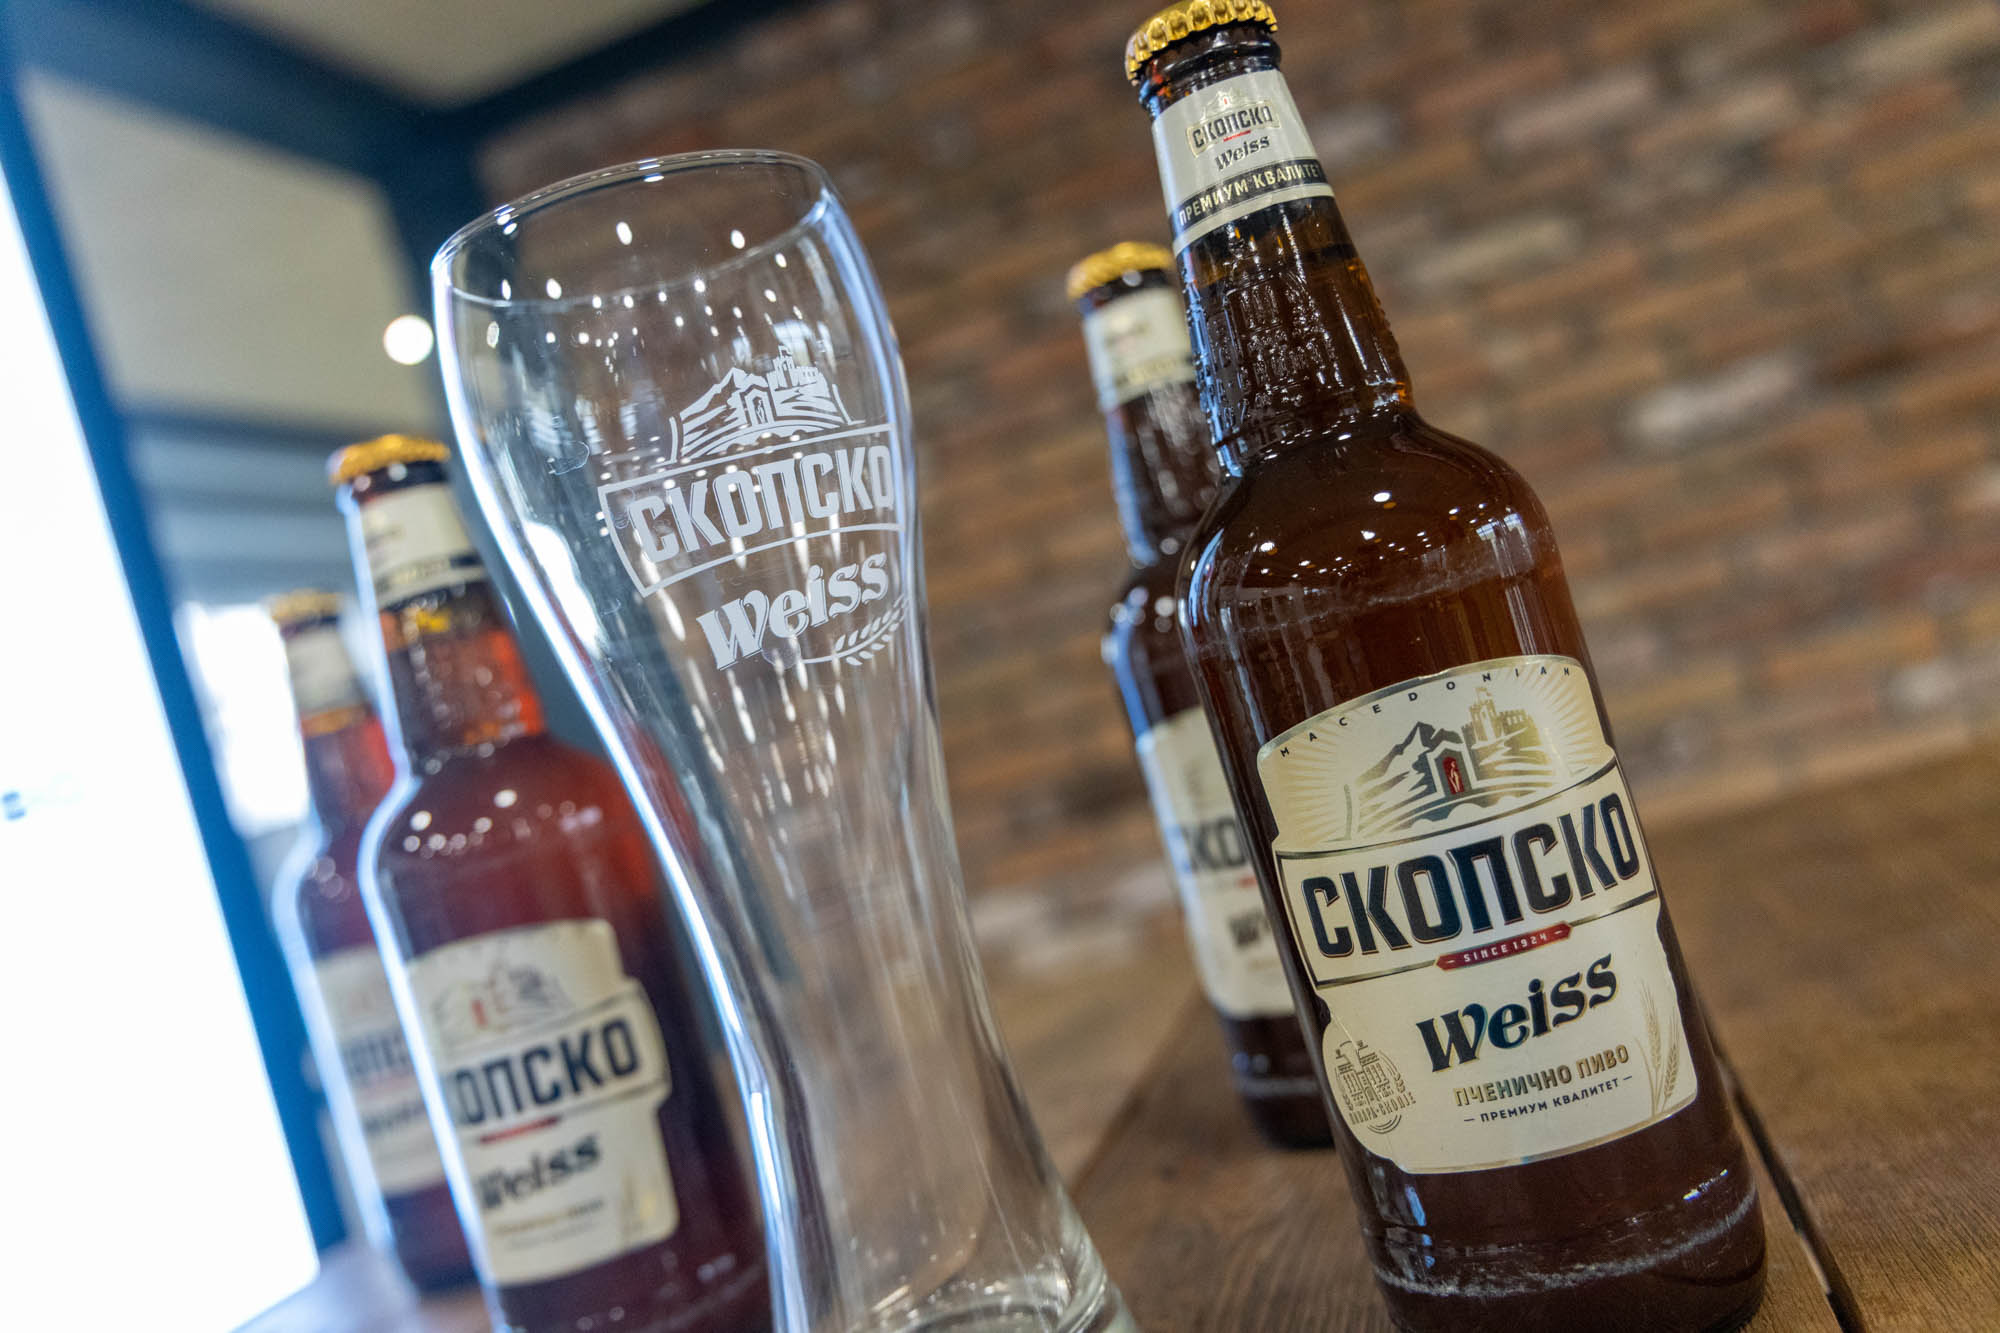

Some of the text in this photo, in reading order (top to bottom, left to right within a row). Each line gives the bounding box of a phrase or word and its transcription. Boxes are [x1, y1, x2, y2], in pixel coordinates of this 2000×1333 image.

[1192, 105, 1273, 149] СКОПСКО
[1214, 134, 1270, 171] Weiss
[1178, 178, 1248, 226] ПРЕМИУМ
[627, 445, 895, 563] СКОПСКО
[696, 552, 889, 671] Weiss
[1280, 666, 1571, 758] MACEDONIAN
[1301, 792, 1640, 957] СКОПСКО
[1463, 933, 1547, 962] SINCE 1924
[1416, 952, 1619, 1073] Weiss
[1453, 1044, 1630, 1107] ПЧЕНИЧНО ПИВО
[1480, 1078, 1619, 1123] ПРЕМИУМ КВАЛИТЕТ
